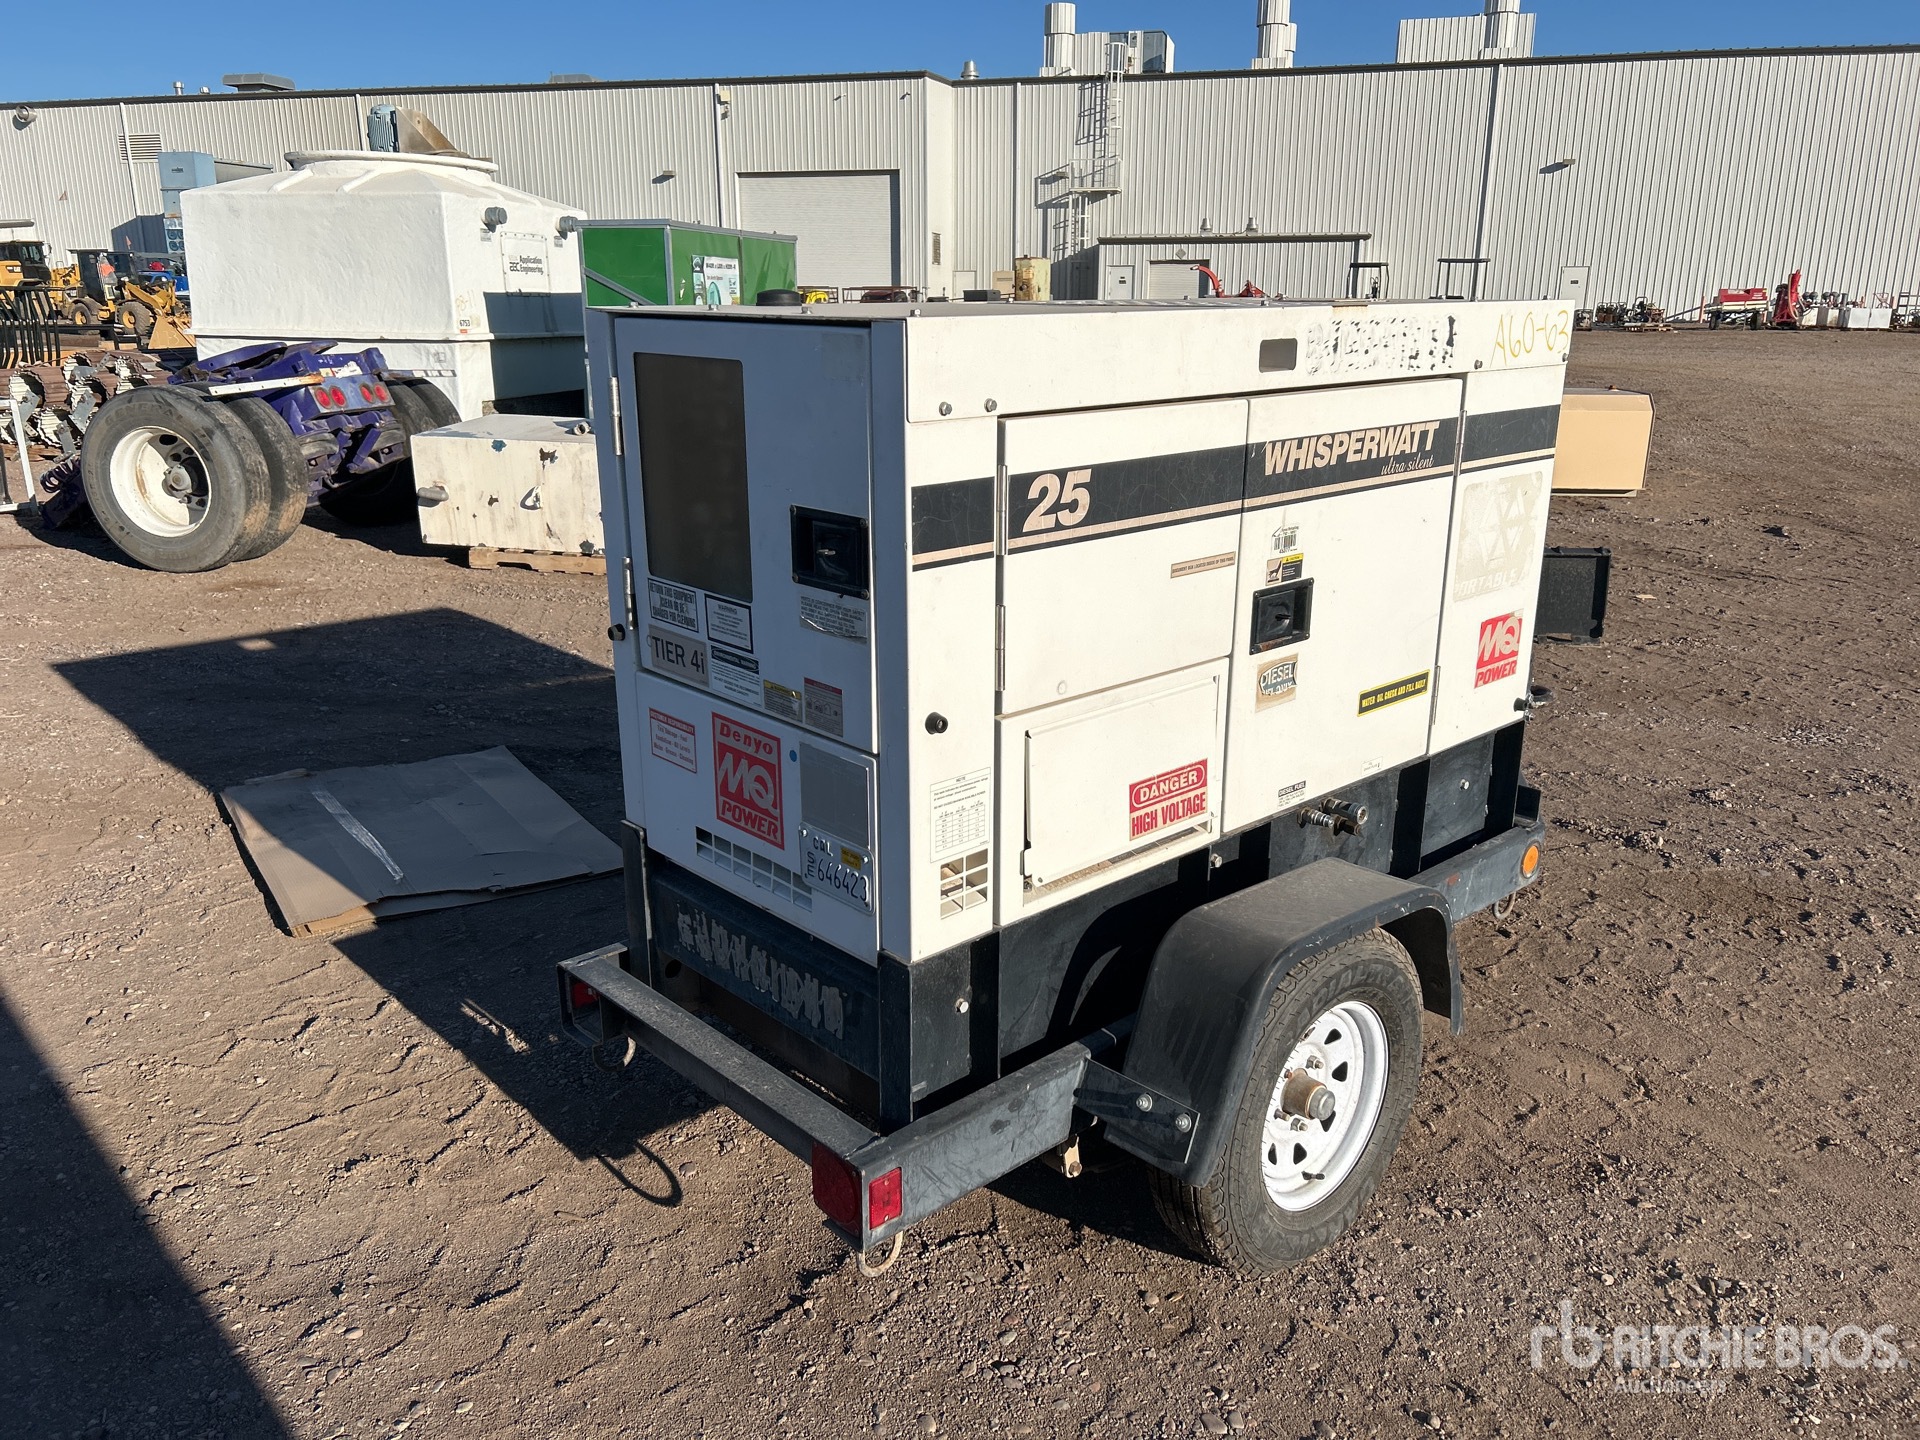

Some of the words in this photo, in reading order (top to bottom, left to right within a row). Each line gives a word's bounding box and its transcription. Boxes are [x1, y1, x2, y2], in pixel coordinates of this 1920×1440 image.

[520, 255, 542, 265] Application
[1490, 310, 1569, 368] A60-63
[1265, 421, 1440, 476] WHISPERWATT
[1381, 457, 1406, 476] ultra
[1407, 452, 1435, 472] silent
[1022, 469, 1092, 533] 25
[652, 636, 686, 668] TIER
[691, 650, 705, 675] 4i
[1478, 616, 1520, 662] MQ
[1260, 664, 1293, 686] DIESEL
[1475, 660, 1517, 688] POWER
[1362, 695, 1376, 707] WATER
[1385, 689, 1397, 700] CHECK
[1398, 685, 1406, 696] AND
[1406, 683, 1414, 692] FILL
[720, 722, 773, 755] Denyo
[717, 752, 778, 817] MQ
[1139, 770, 1198, 802] DANGER
[1279, 786, 1294, 796] DIESEL
[1294, 782, 1305, 791] FUEL
[721, 800, 778, 840] POWER
[1131, 809, 1158, 837] HIGH
[1161, 792, 1206, 825] VOLTAGE
[813, 836, 834, 857] CAL
[818, 858, 870, 904] 646423
